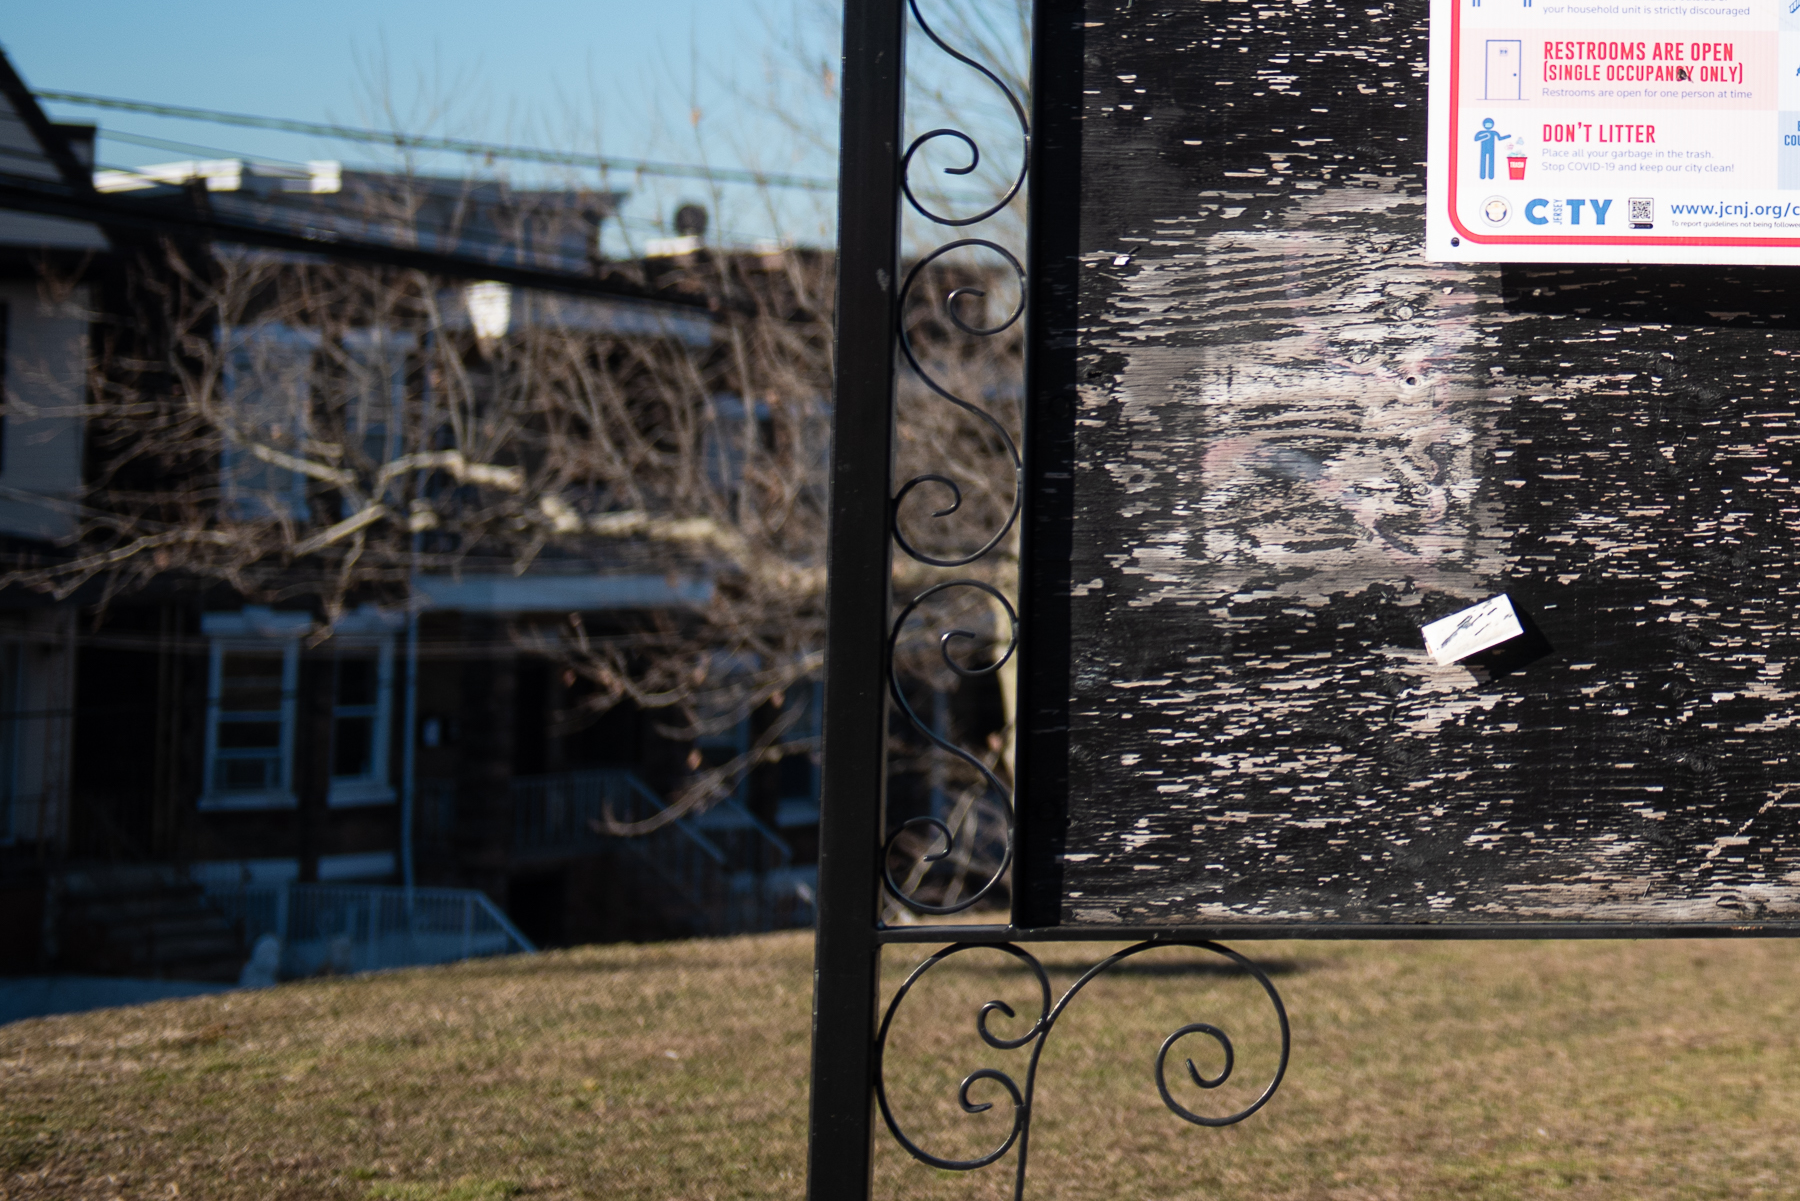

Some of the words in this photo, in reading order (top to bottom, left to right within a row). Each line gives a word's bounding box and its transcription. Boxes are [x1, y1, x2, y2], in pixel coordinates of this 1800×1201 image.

[1543, 6, 1565, 14] your
[1567, 5, 1619, 13] household
[1622, 5, 1641, 13] unit
[1644, 6, 1652, 14] is
[1654, 5, 1688, 15] strictly
[1689, 6, 1750, 17] discouraged
[1544, 41, 1646, 62] RESTROOMS
[1652, 42, 1684, 60] ARE
[1691, 42, 1733, 61] OPEN
[1544, 60, 1601, 82] (SINGLE
[1606, 64, 1694, 82] OCCUPANCY
[1700, 62, 1743, 84] ONLY)
[1542, 87, 1596, 97] Restrooms
[1616, 90, 1642, 98] open
[1644, 88, 1658, 97] for
[1681, 90, 1715, 99] person
[1717, 90, 1728, 98] at
[1730, 89, 1753, 98] time
[1543, 121, 1593, 143] DON'T
[1599, 124, 1656, 143] LITTER
[1542, 148, 1569, 157] Place
[1572, 149, 1584, 157] all
[1586, 150, 1609, 159] your
[1611, 149, 1653, 160] garbage
[1655, 149, 1665, 157] in
[1667, 149, 1684, 158] the
[1686, 149, 1714, 158] trash.
[1541, 161, 1565, 172] Stop
[1567, 162, 1616, 171] COVID-19
[1618, 163, 1637, 171] and
[1639, 163, 1664, 173] keep
[1684, 164, 1703, 173] city
[1704, 164, 1735, 172] clean!
[1552, 199, 1563, 226] JERSEY
[1680, 220, 1702, 229] report
[1703, 220, 1739, 229] guidelines
[1753, 221, 1773, 230] being
